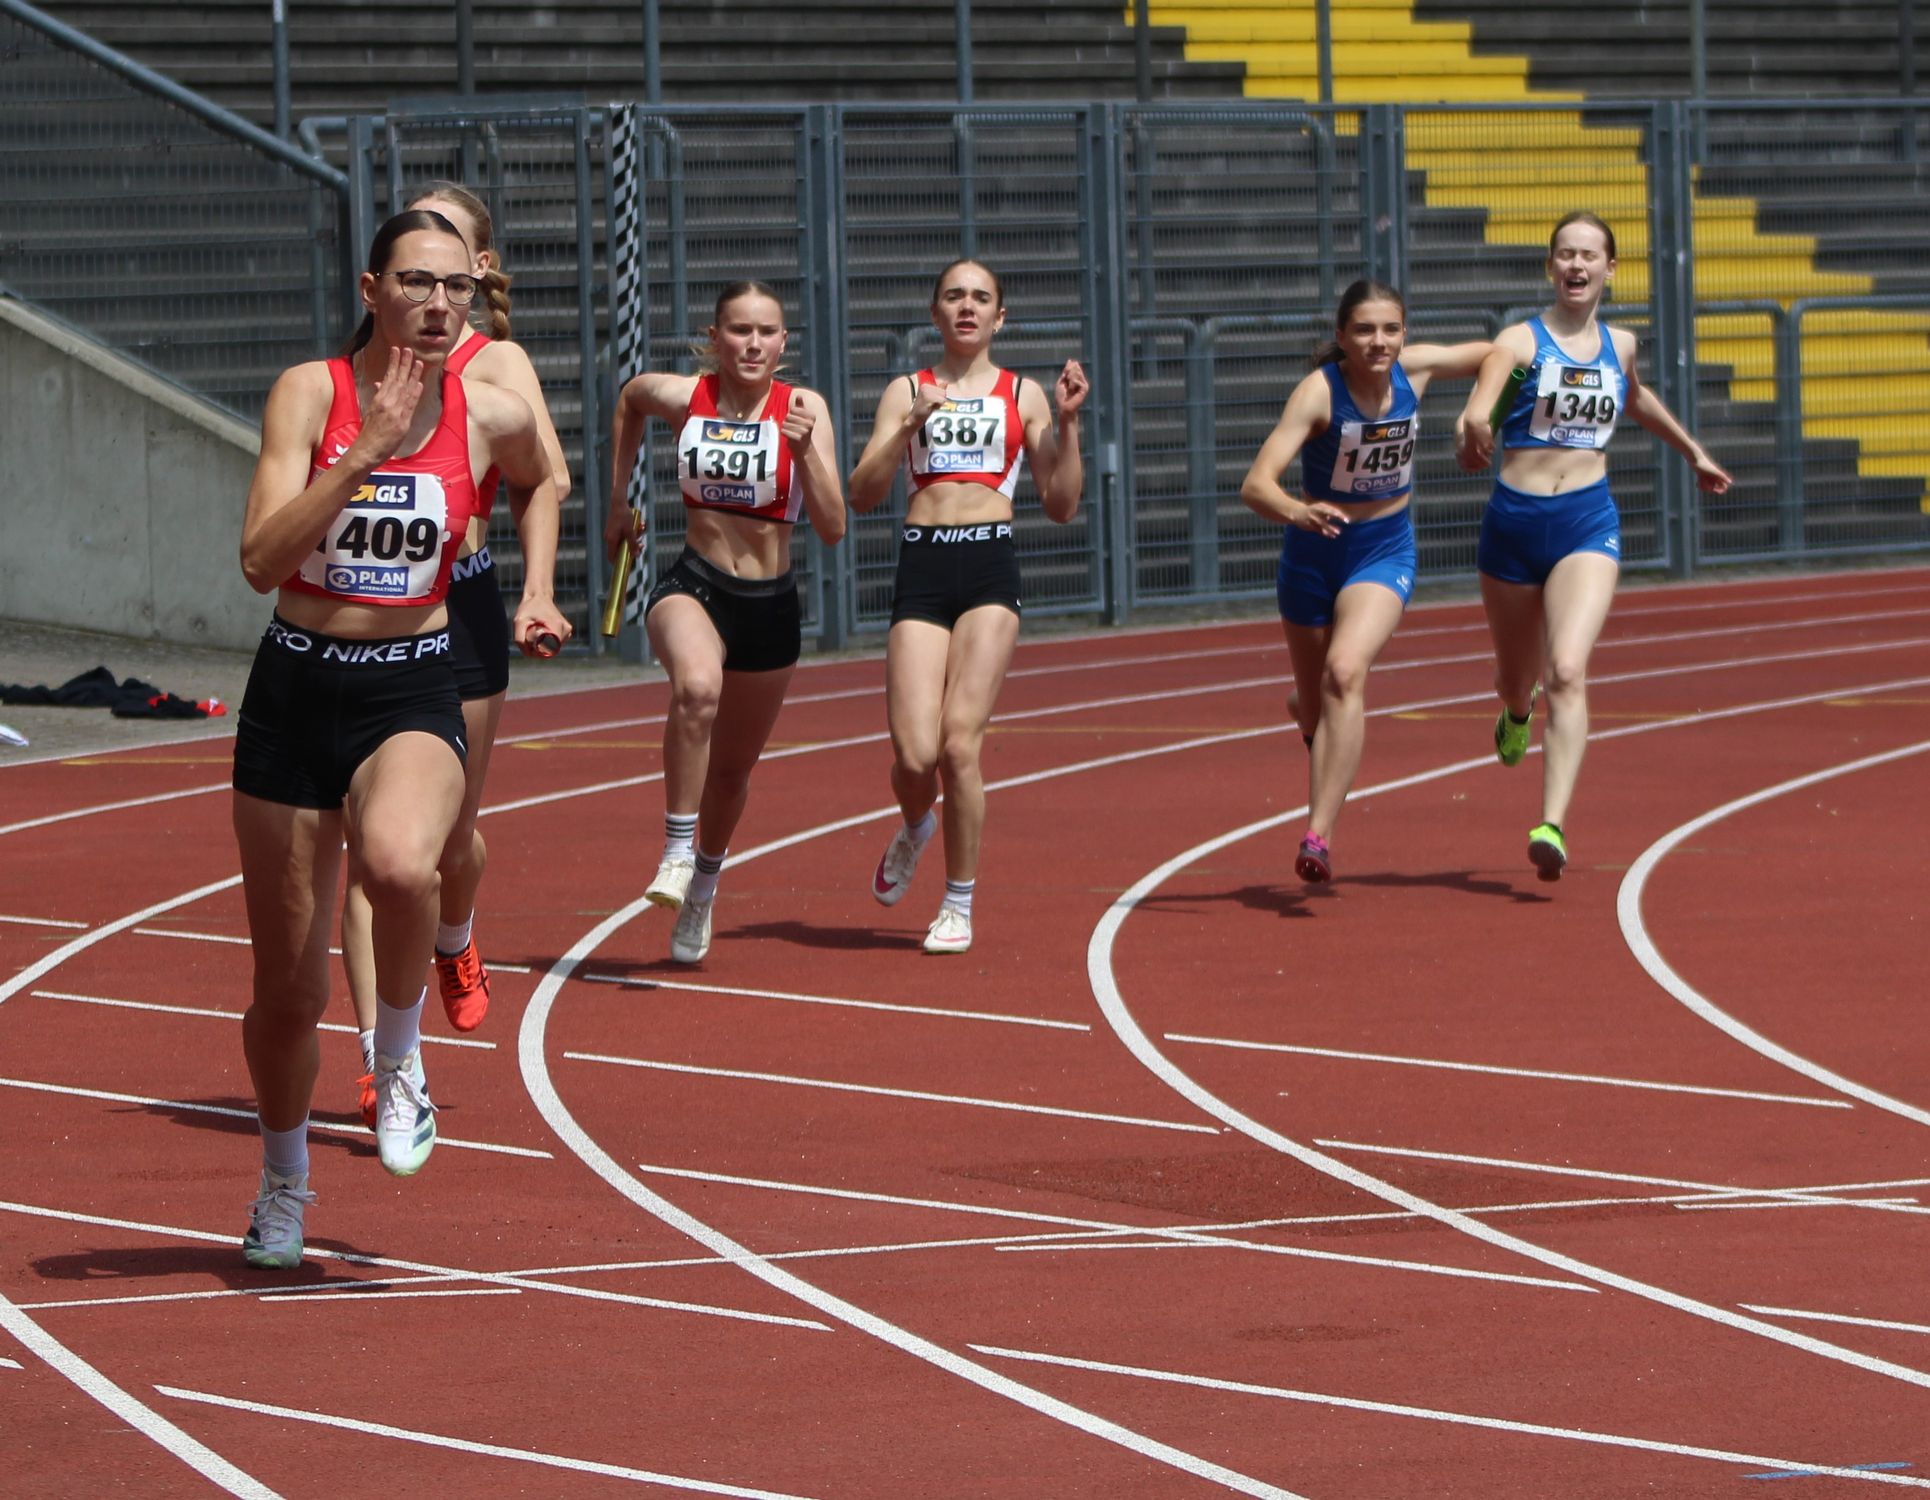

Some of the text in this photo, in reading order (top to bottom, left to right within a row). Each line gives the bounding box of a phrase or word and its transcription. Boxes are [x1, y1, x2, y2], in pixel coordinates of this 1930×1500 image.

[1582, 374, 1599, 387] GLS
[956, 402, 980, 413] GLS
[1543, 391, 1615, 424] 1349
[732, 429, 757, 443] GLS
[1387, 425, 1407, 438] GLS
[1568, 428, 1595, 439] PLAN
[950, 454, 981, 464] PLAN
[1343, 438, 1414, 474] 1459
[683, 446, 768, 482] 1391
[1372, 475, 1399, 487] PLAN
[375, 485, 409, 503] GLS
[723, 487, 753, 500] PLAN
[316, 516, 438, 562] 409
[931, 525, 992, 543] NIKE
[359, 570, 406, 586] PLAN
[358, 585, 405, 593] INTERNATIONAL
[322, 642, 412, 663] NIKE
[414, 632, 450, 660] PR
